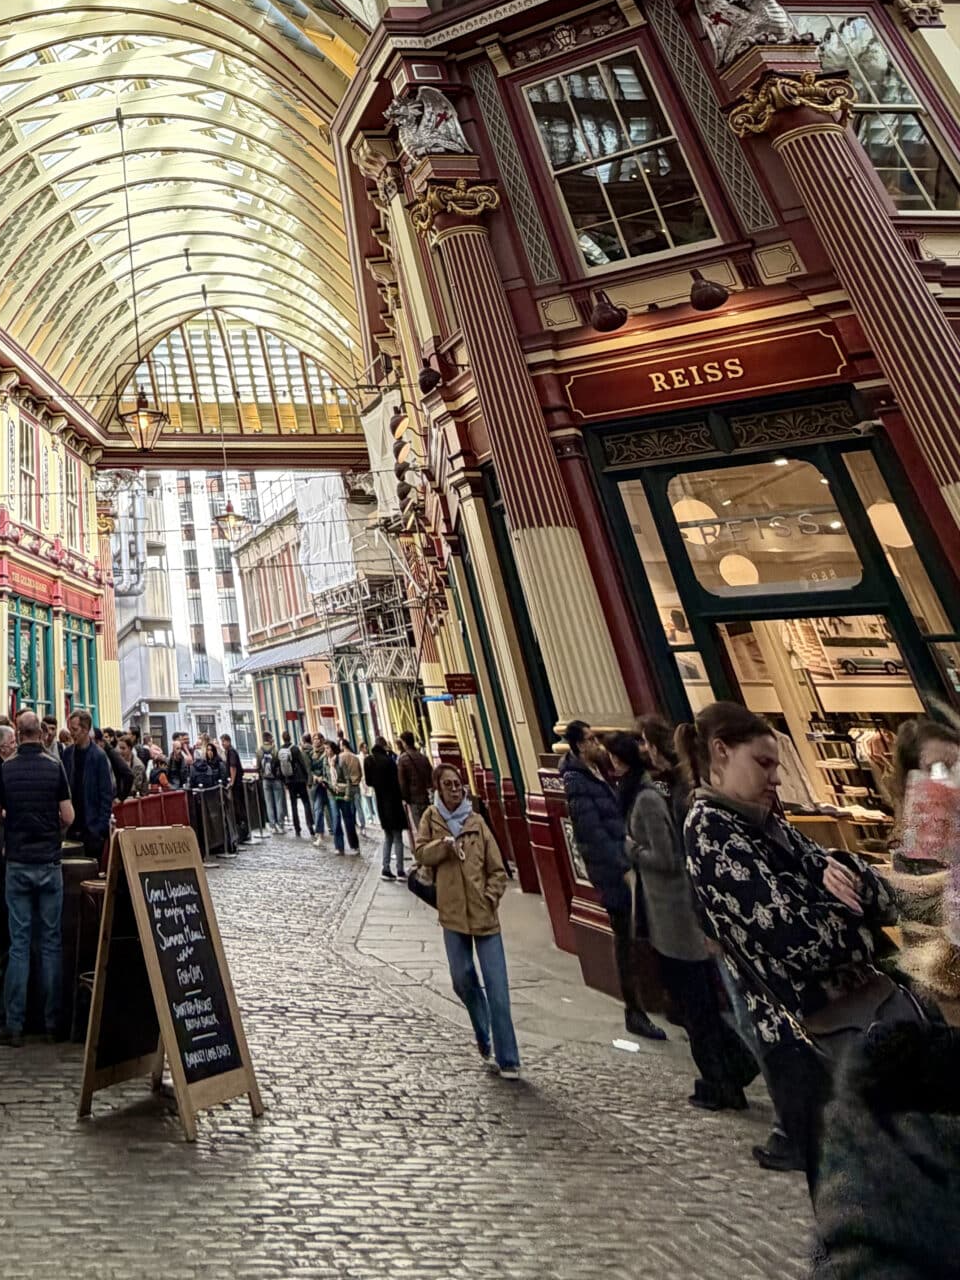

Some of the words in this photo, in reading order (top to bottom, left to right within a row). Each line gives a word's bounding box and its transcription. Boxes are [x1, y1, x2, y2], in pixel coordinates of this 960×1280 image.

[648, 358, 744, 392] REISS
[699, 512, 820, 545] REISS
[133, 841, 159, 857] LAMB
[159, 839, 193, 856] TAVERN
[163, 904, 186, 925] enjoy
[185, 903, 201, 915] our
